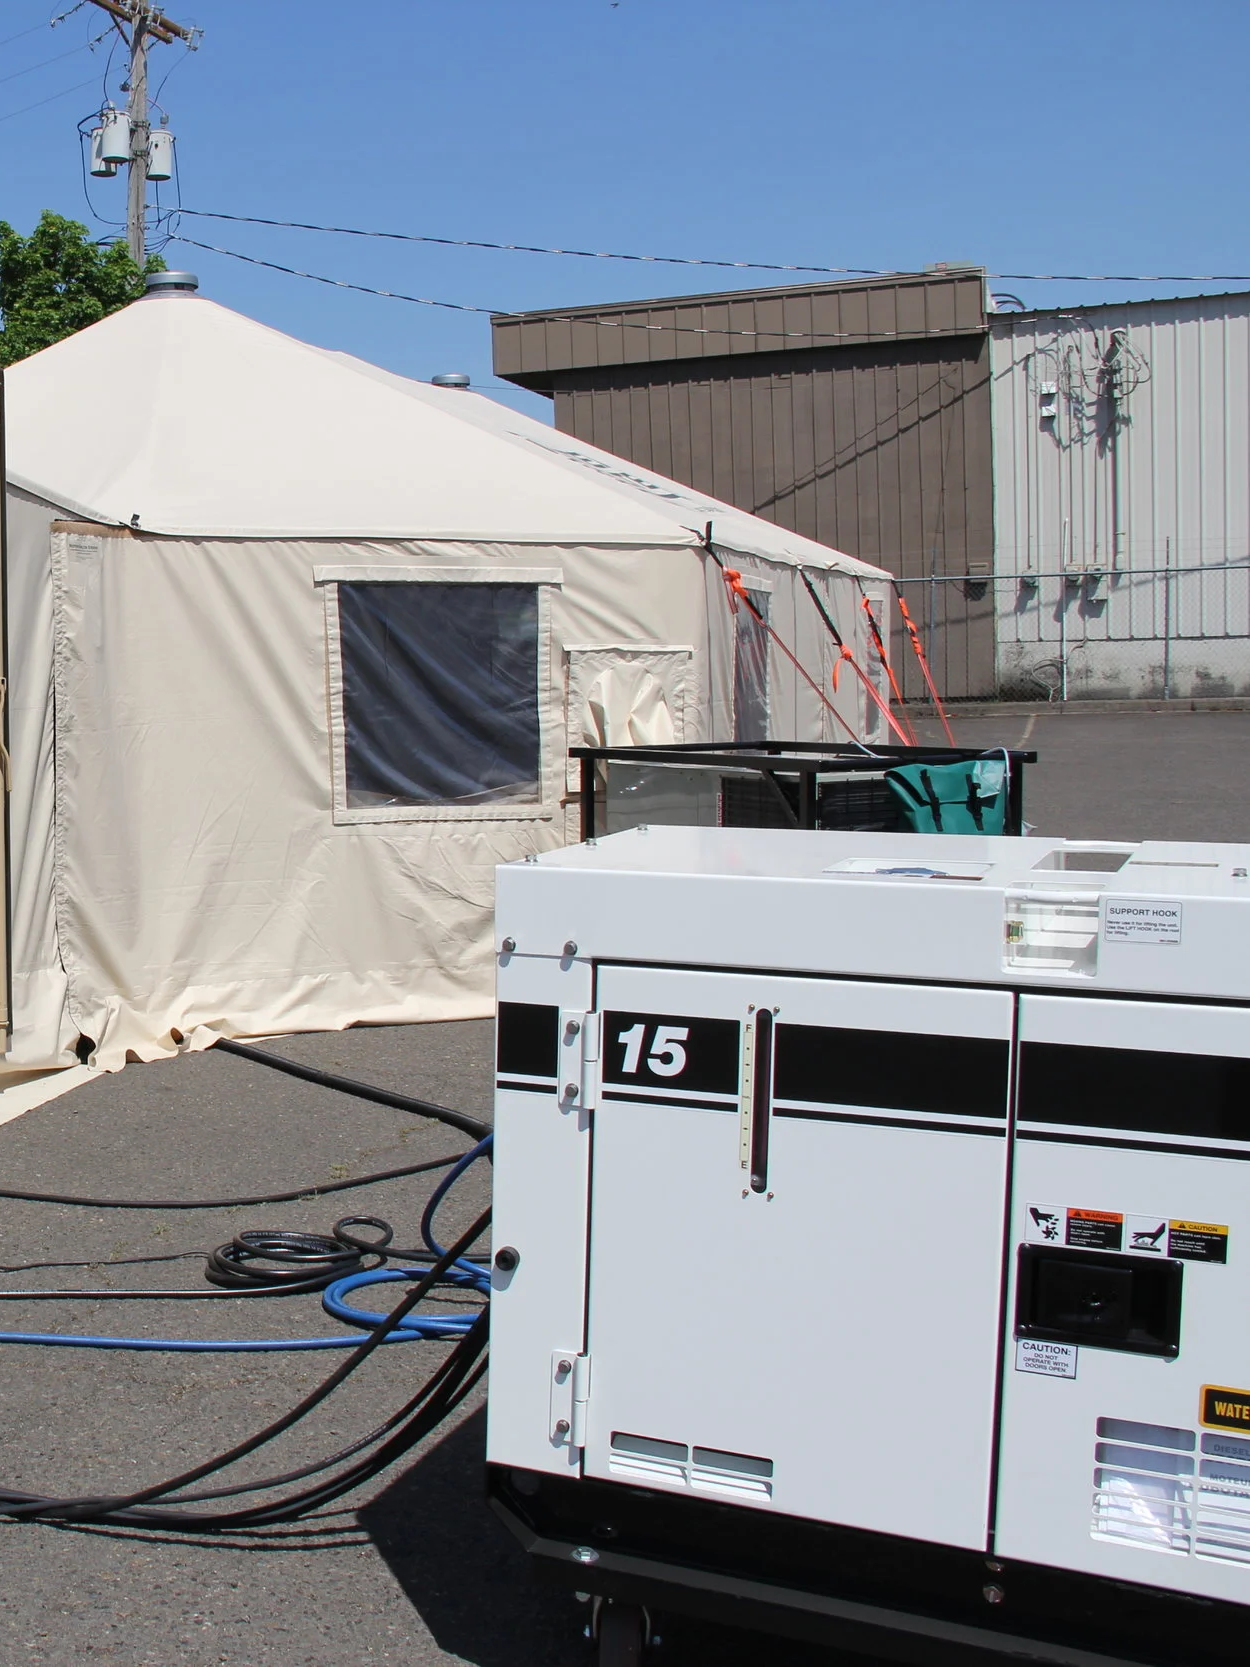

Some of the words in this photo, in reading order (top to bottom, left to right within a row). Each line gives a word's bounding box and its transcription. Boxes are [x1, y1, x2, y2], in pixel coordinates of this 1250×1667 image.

[1110, 908, 1150, 916] SUPPORT
[745, 1024, 752, 1032] F
[617, 1023, 690, 1077] 15
[741, 1161, 748, 1169] E
[1084, 1211, 1119, 1221] WARNING
[1188, 1224, 1218, 1233] CAUTION
[1022, 1342, 1071, 1356] CAUTION:
[1023, 1356, 1051, 1365] OPERATE
[1025, 1362, 1047, 1370] DOORS
